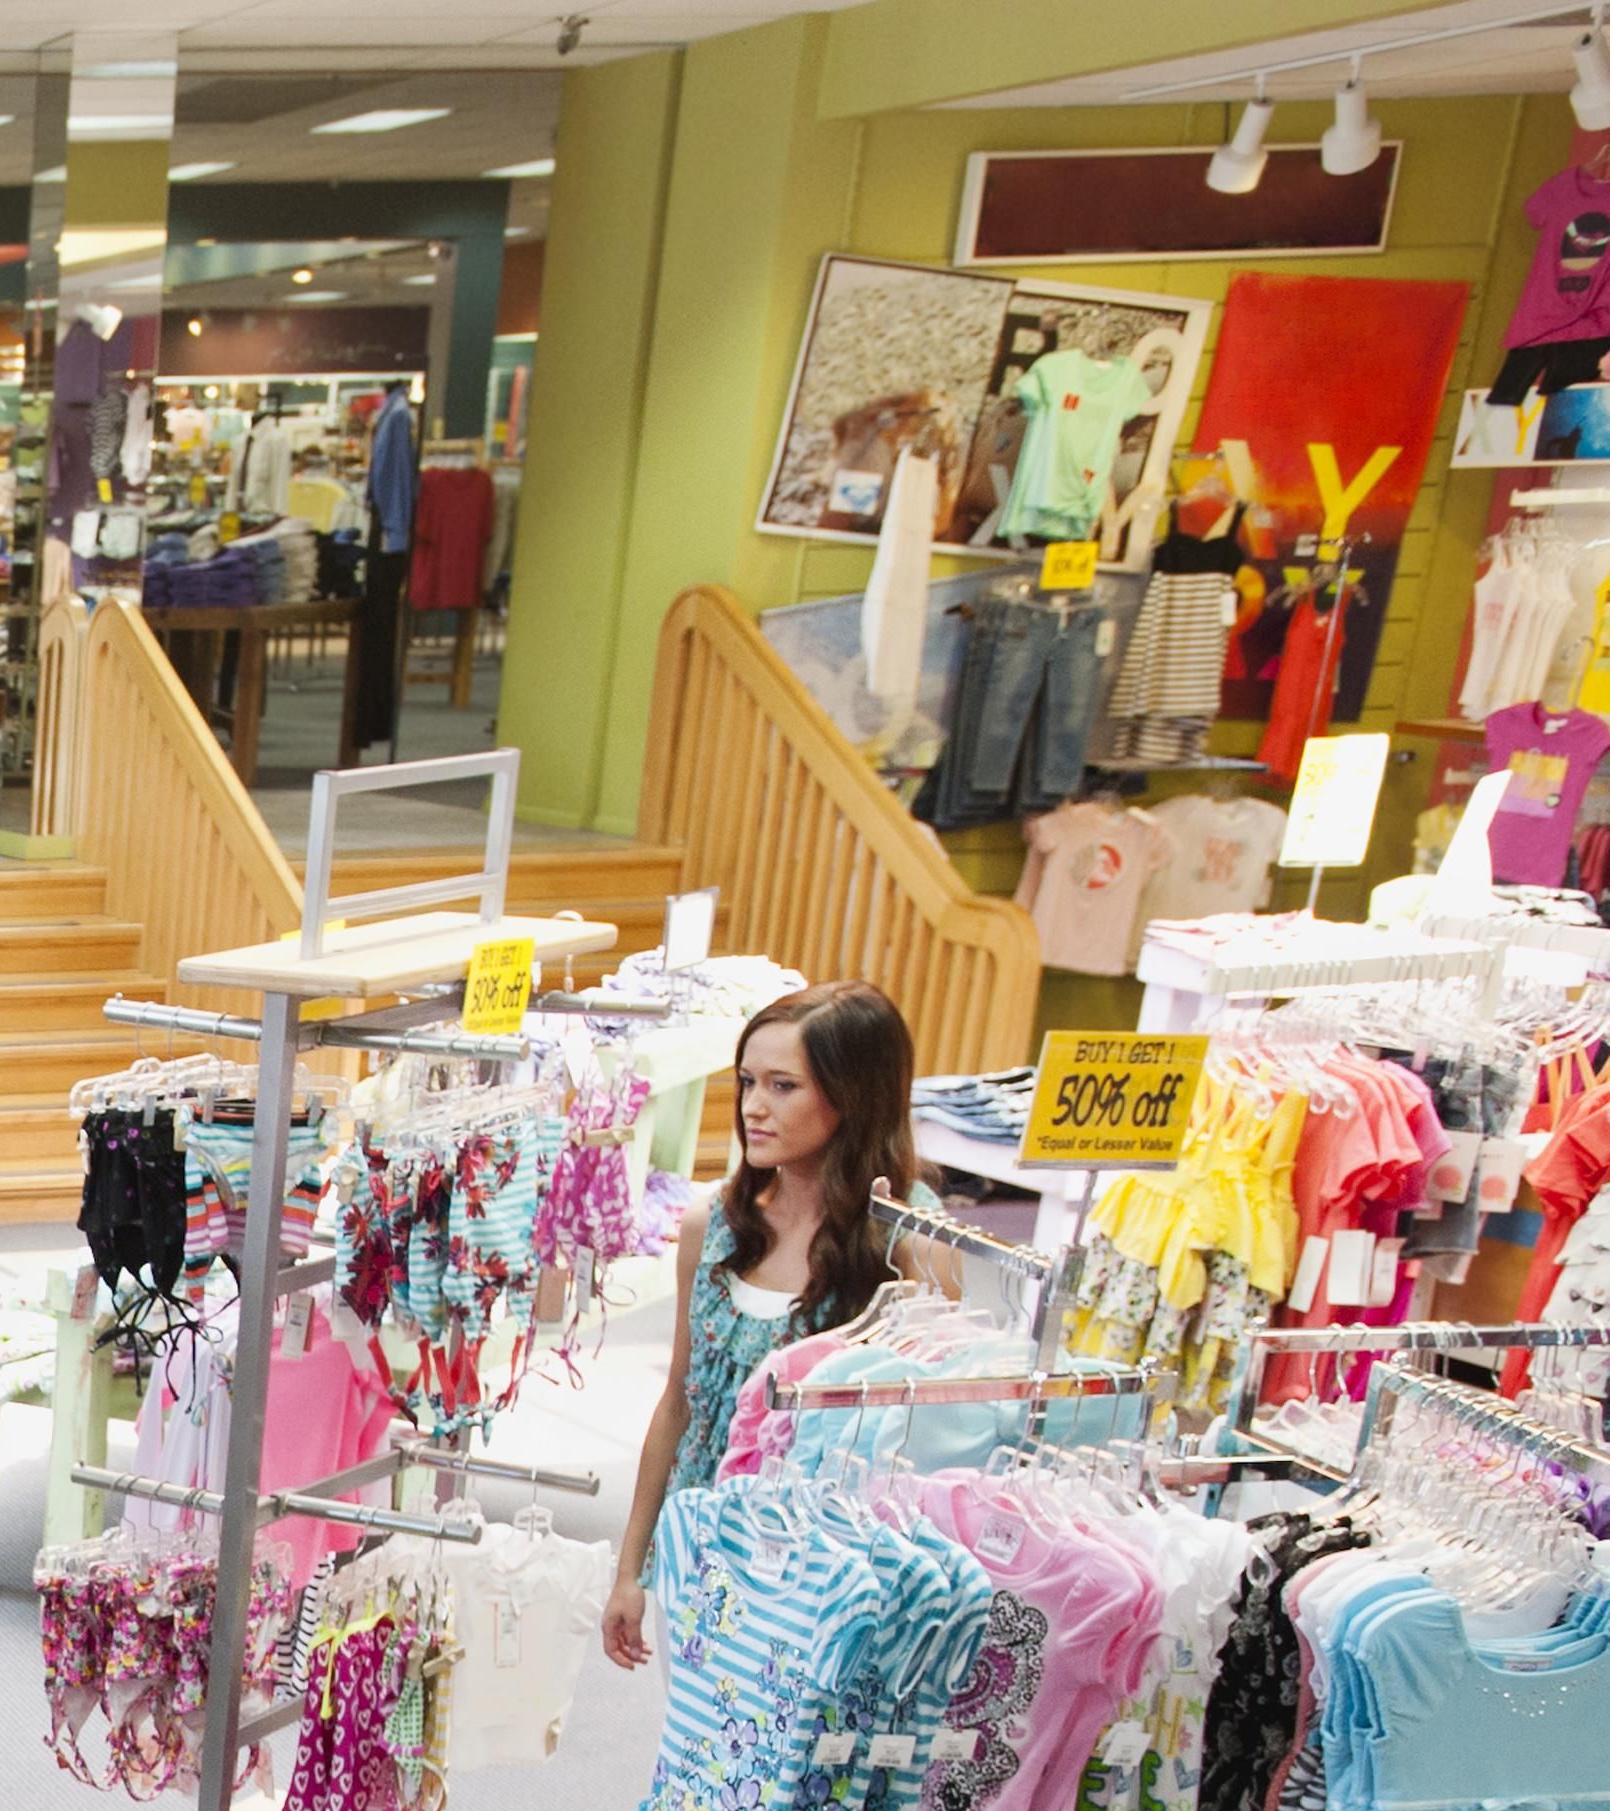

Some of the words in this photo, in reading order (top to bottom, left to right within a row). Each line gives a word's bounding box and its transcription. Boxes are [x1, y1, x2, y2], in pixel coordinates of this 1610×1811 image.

[502, 971, 527, 1008] off
[1074, 1040, 1115, 1064] BUY
[1127, 1041, 1166, 1064] GET
[1052, 1072, 1130, 1127] 50%
[1132, 1073, 1184, 1127] off
[1079, 1139, 1093, 1150] or
[1095, 1137, 1137, 1150] Lesser
[1139, 1137, 1173, 1150] Value
